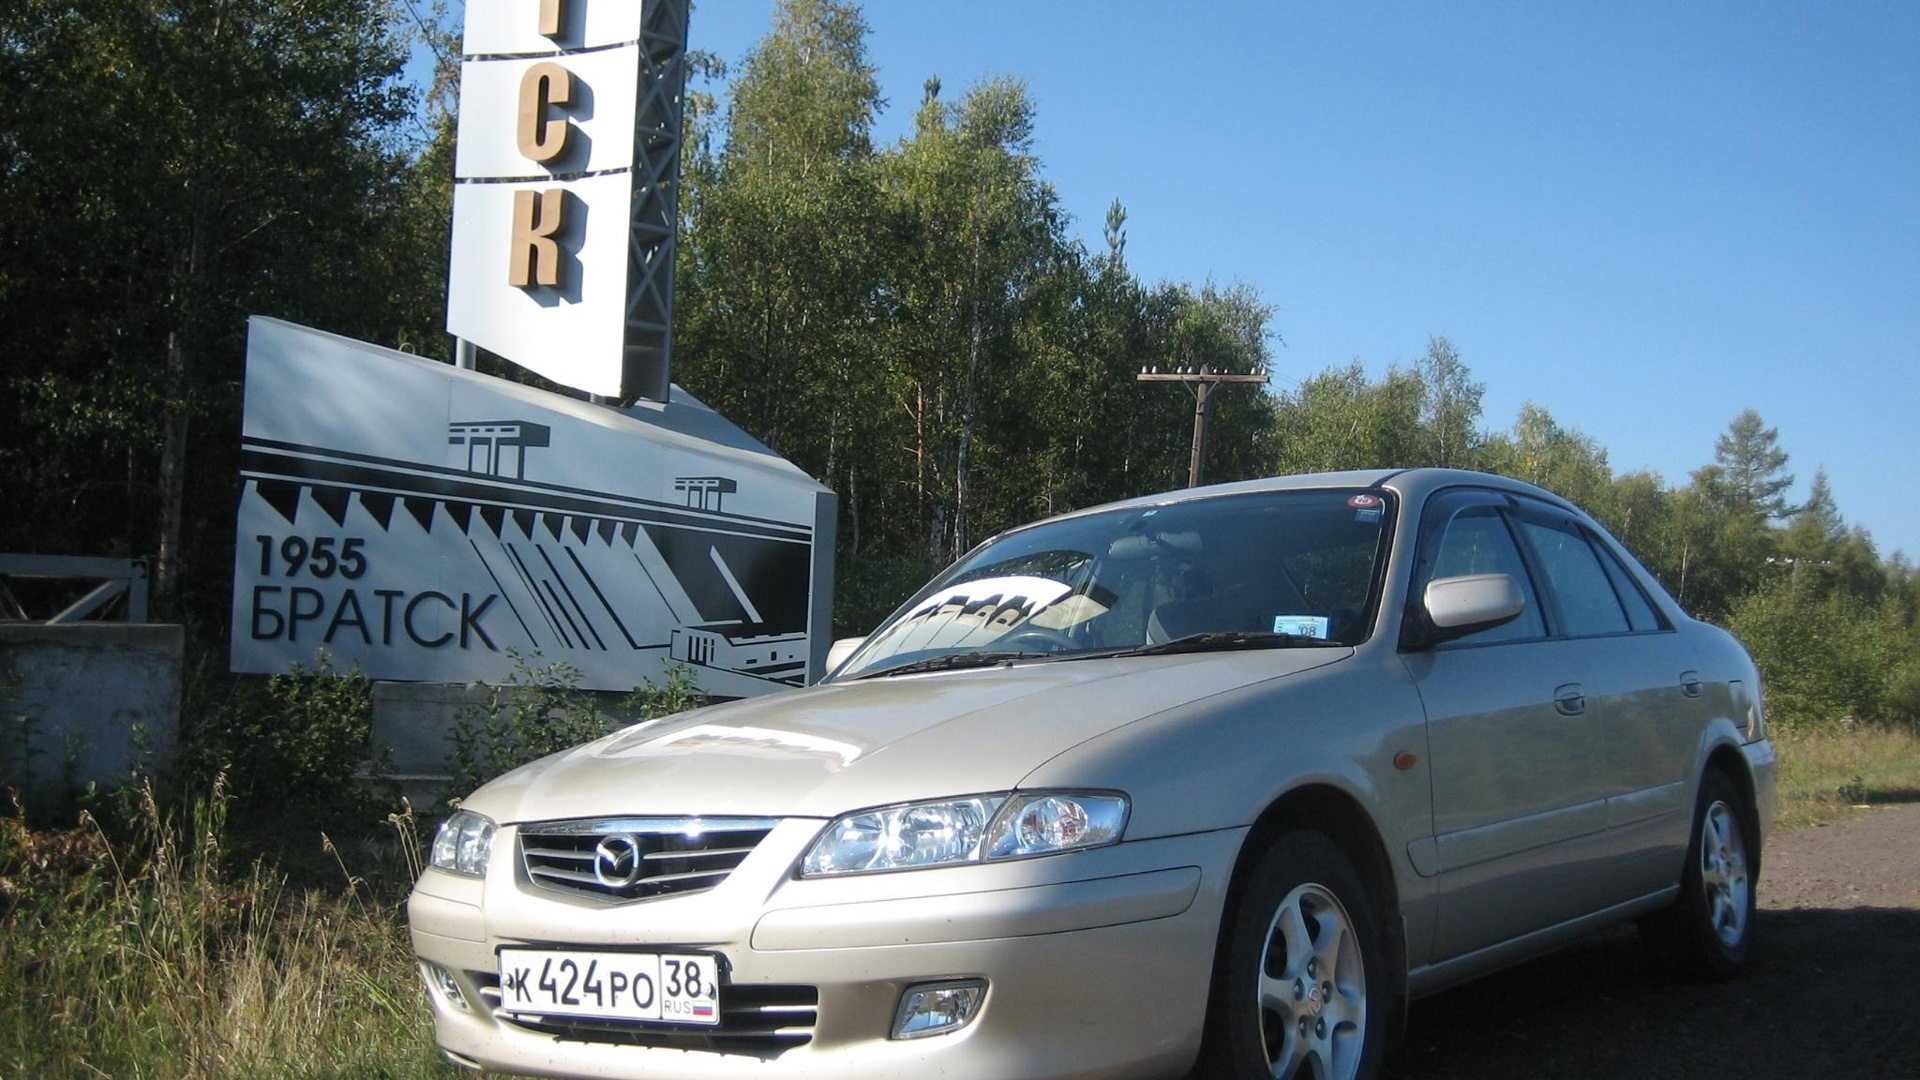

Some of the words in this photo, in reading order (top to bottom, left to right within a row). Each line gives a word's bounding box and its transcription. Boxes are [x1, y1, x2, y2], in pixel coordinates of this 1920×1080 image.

[256, 534, 367, 580] 1955
[251, 584, 499, 651] БРАТСК
[665, 960, 702, 998] 38
[664, 1001, 691, 1014] RUS
